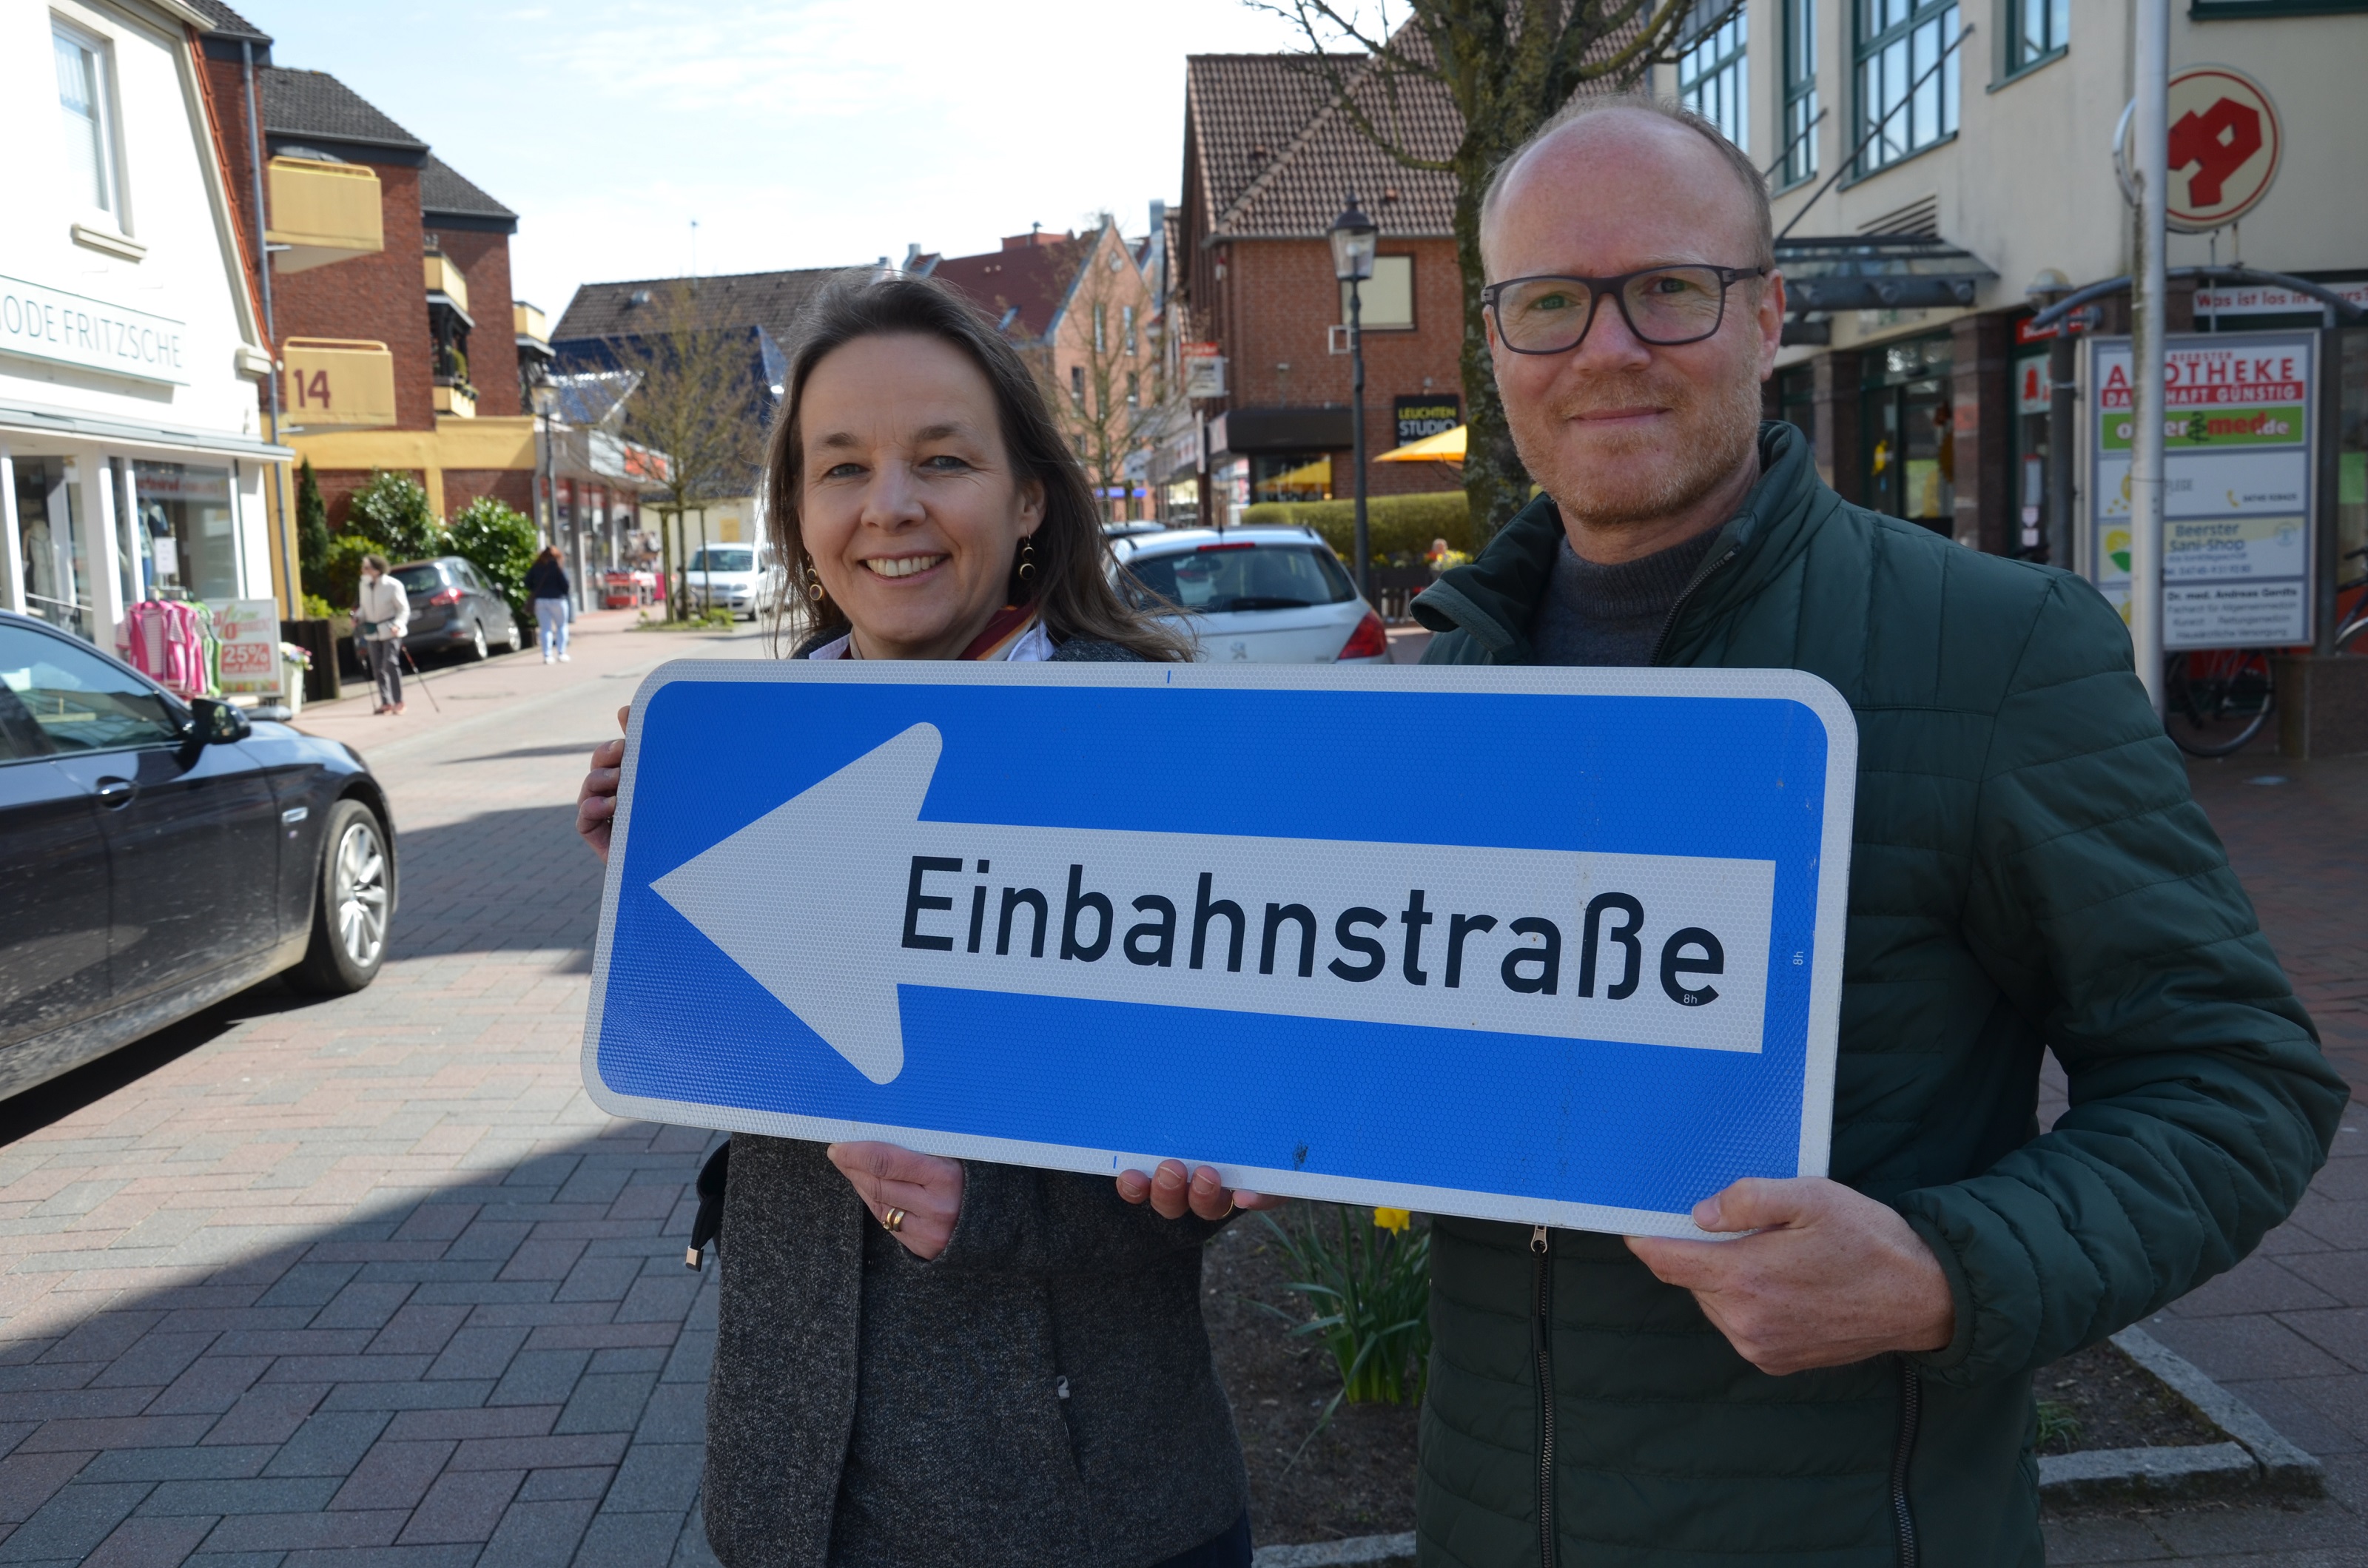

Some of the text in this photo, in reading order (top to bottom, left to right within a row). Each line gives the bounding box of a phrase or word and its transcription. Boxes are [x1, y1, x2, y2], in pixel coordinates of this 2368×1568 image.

[2196, 295, 2232, 308] Was
[2238, 292, 2257, 306] ist
[2263, 290, 2287, 304] los
[0, 295, 183, 369] ODE FRITZSCHE
[2171, 351, 2233, 362] BEERSTER
[2107, 358, 2294, 387] AOTHEKE
[293, 369, 331, 409] 14
[2106, 383, 2296, 406] DAHAFT GÜNSTIG
[1398, 406, 1457, 420] LEUCHTEN
[1398, 420, 1457, 437] STUDIO
[2176, 523, 2239, 537] Beerster
[2169, 538, 2246, 553] Sani-Shop
[224, 646, 268, 664] 25%
[901, 855, 1725, 1008] Einbahnstraße
[1684, 993, 1698, 1004] 8h
